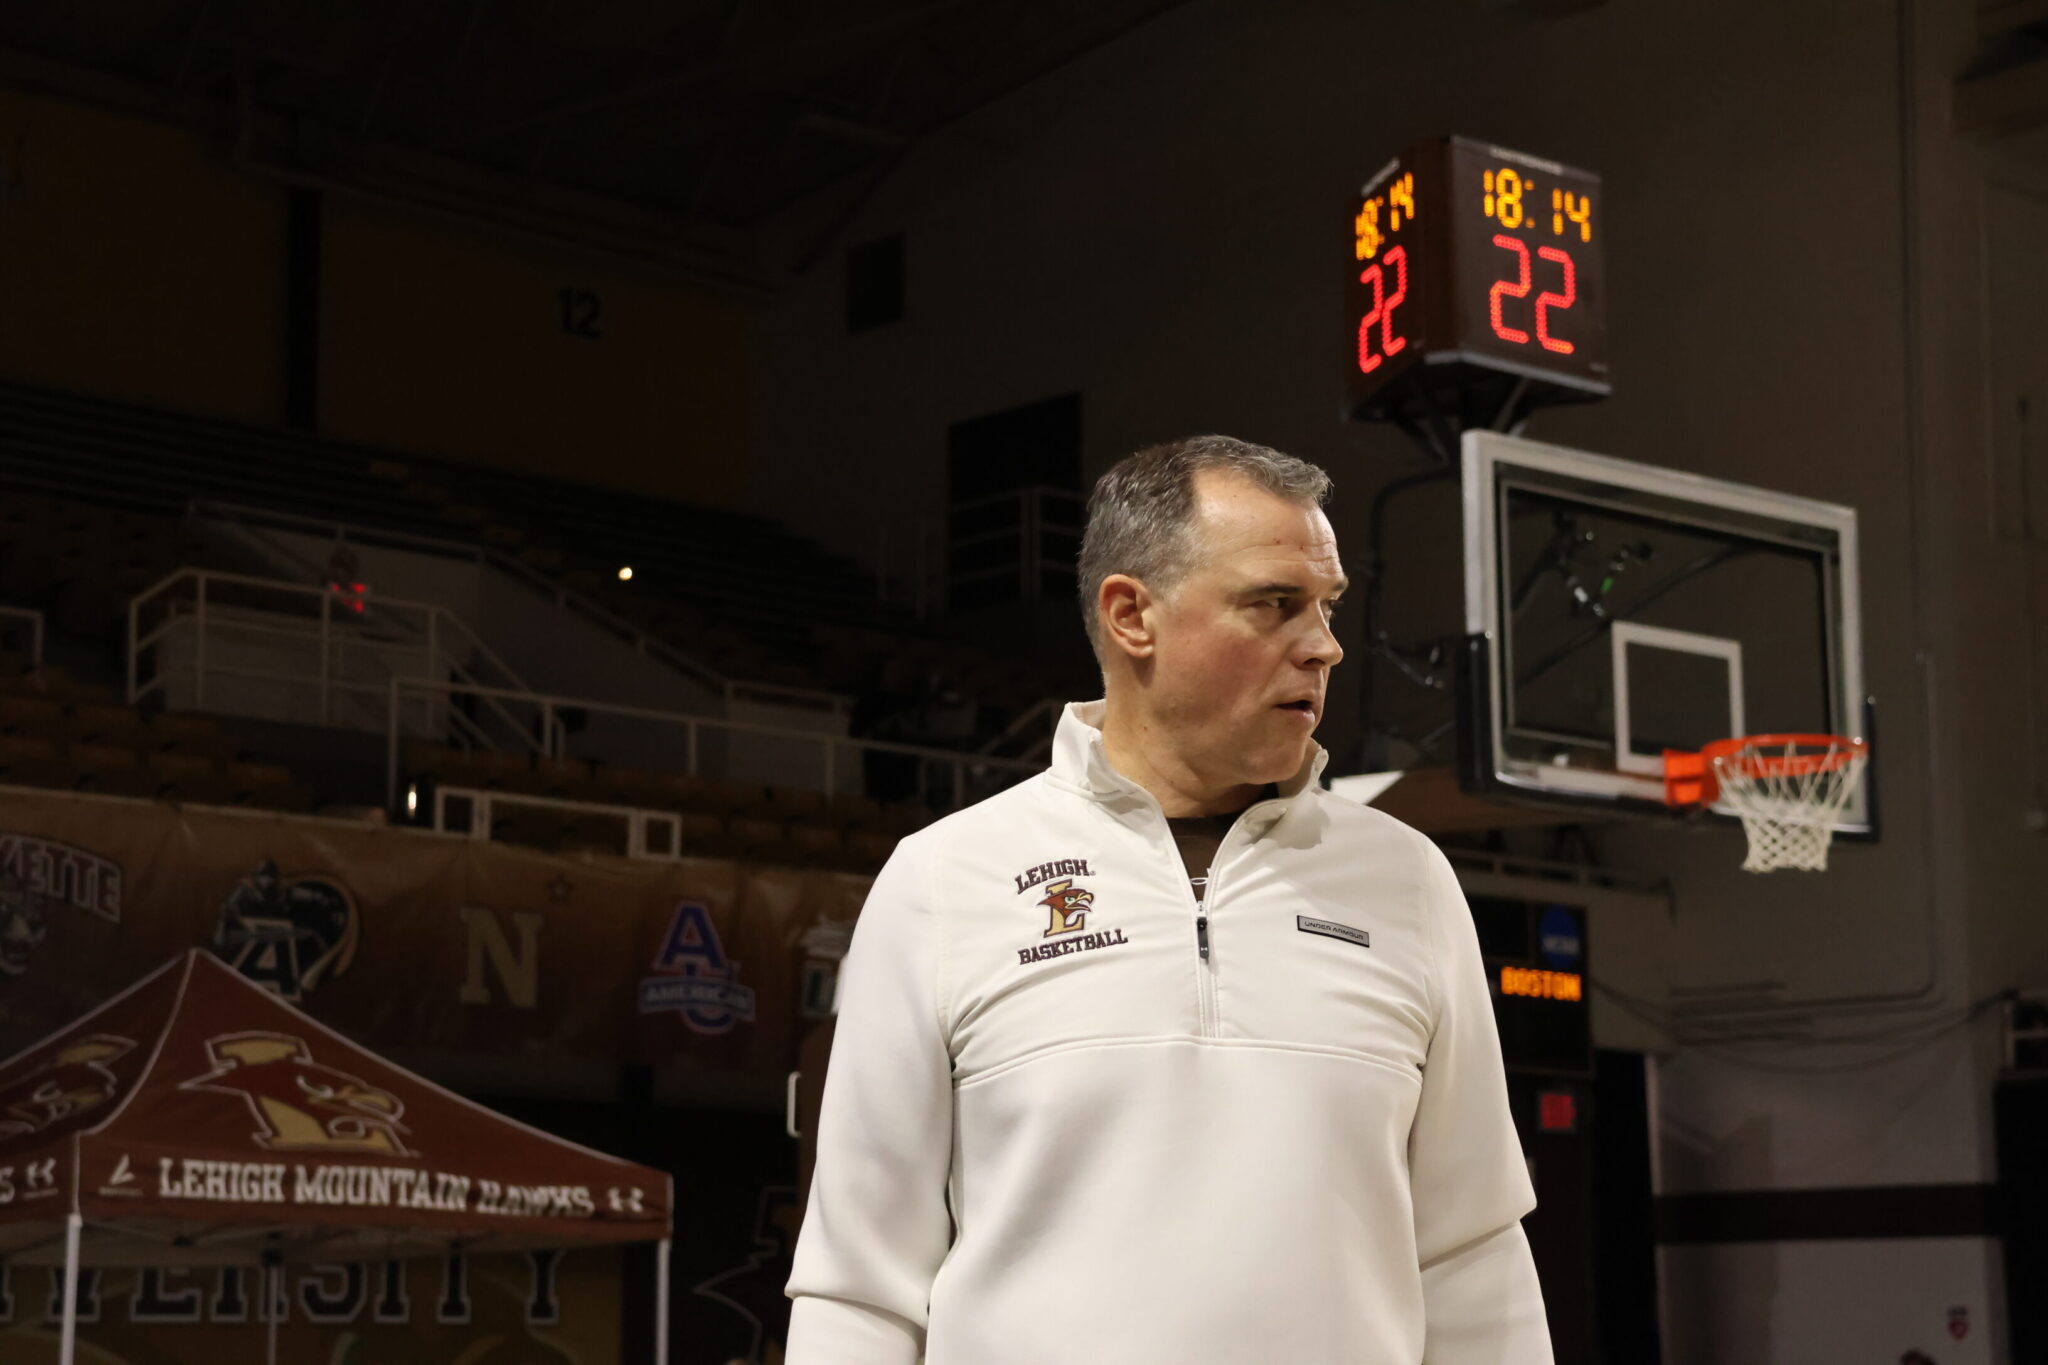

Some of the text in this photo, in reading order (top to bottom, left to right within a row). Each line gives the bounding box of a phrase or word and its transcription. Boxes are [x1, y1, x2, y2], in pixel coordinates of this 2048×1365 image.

[1483, 168, 1591, 243] 18:14
[556, 287, 602, 339] 12
[1358, 244, 1408, 374] 22
[1489, 234, 1576, 355] 22
[1014, 858, 1090, 896] LEHIGH
[458, 905, 545, 1010] N
[1017, 928, 1129, 966] BASKETBALL
[1304, 920, 1364, 941] UNDER ARMOUR
[158, 1156, 596, 1219] LEHIGH MOUNTAIN HAWKS
